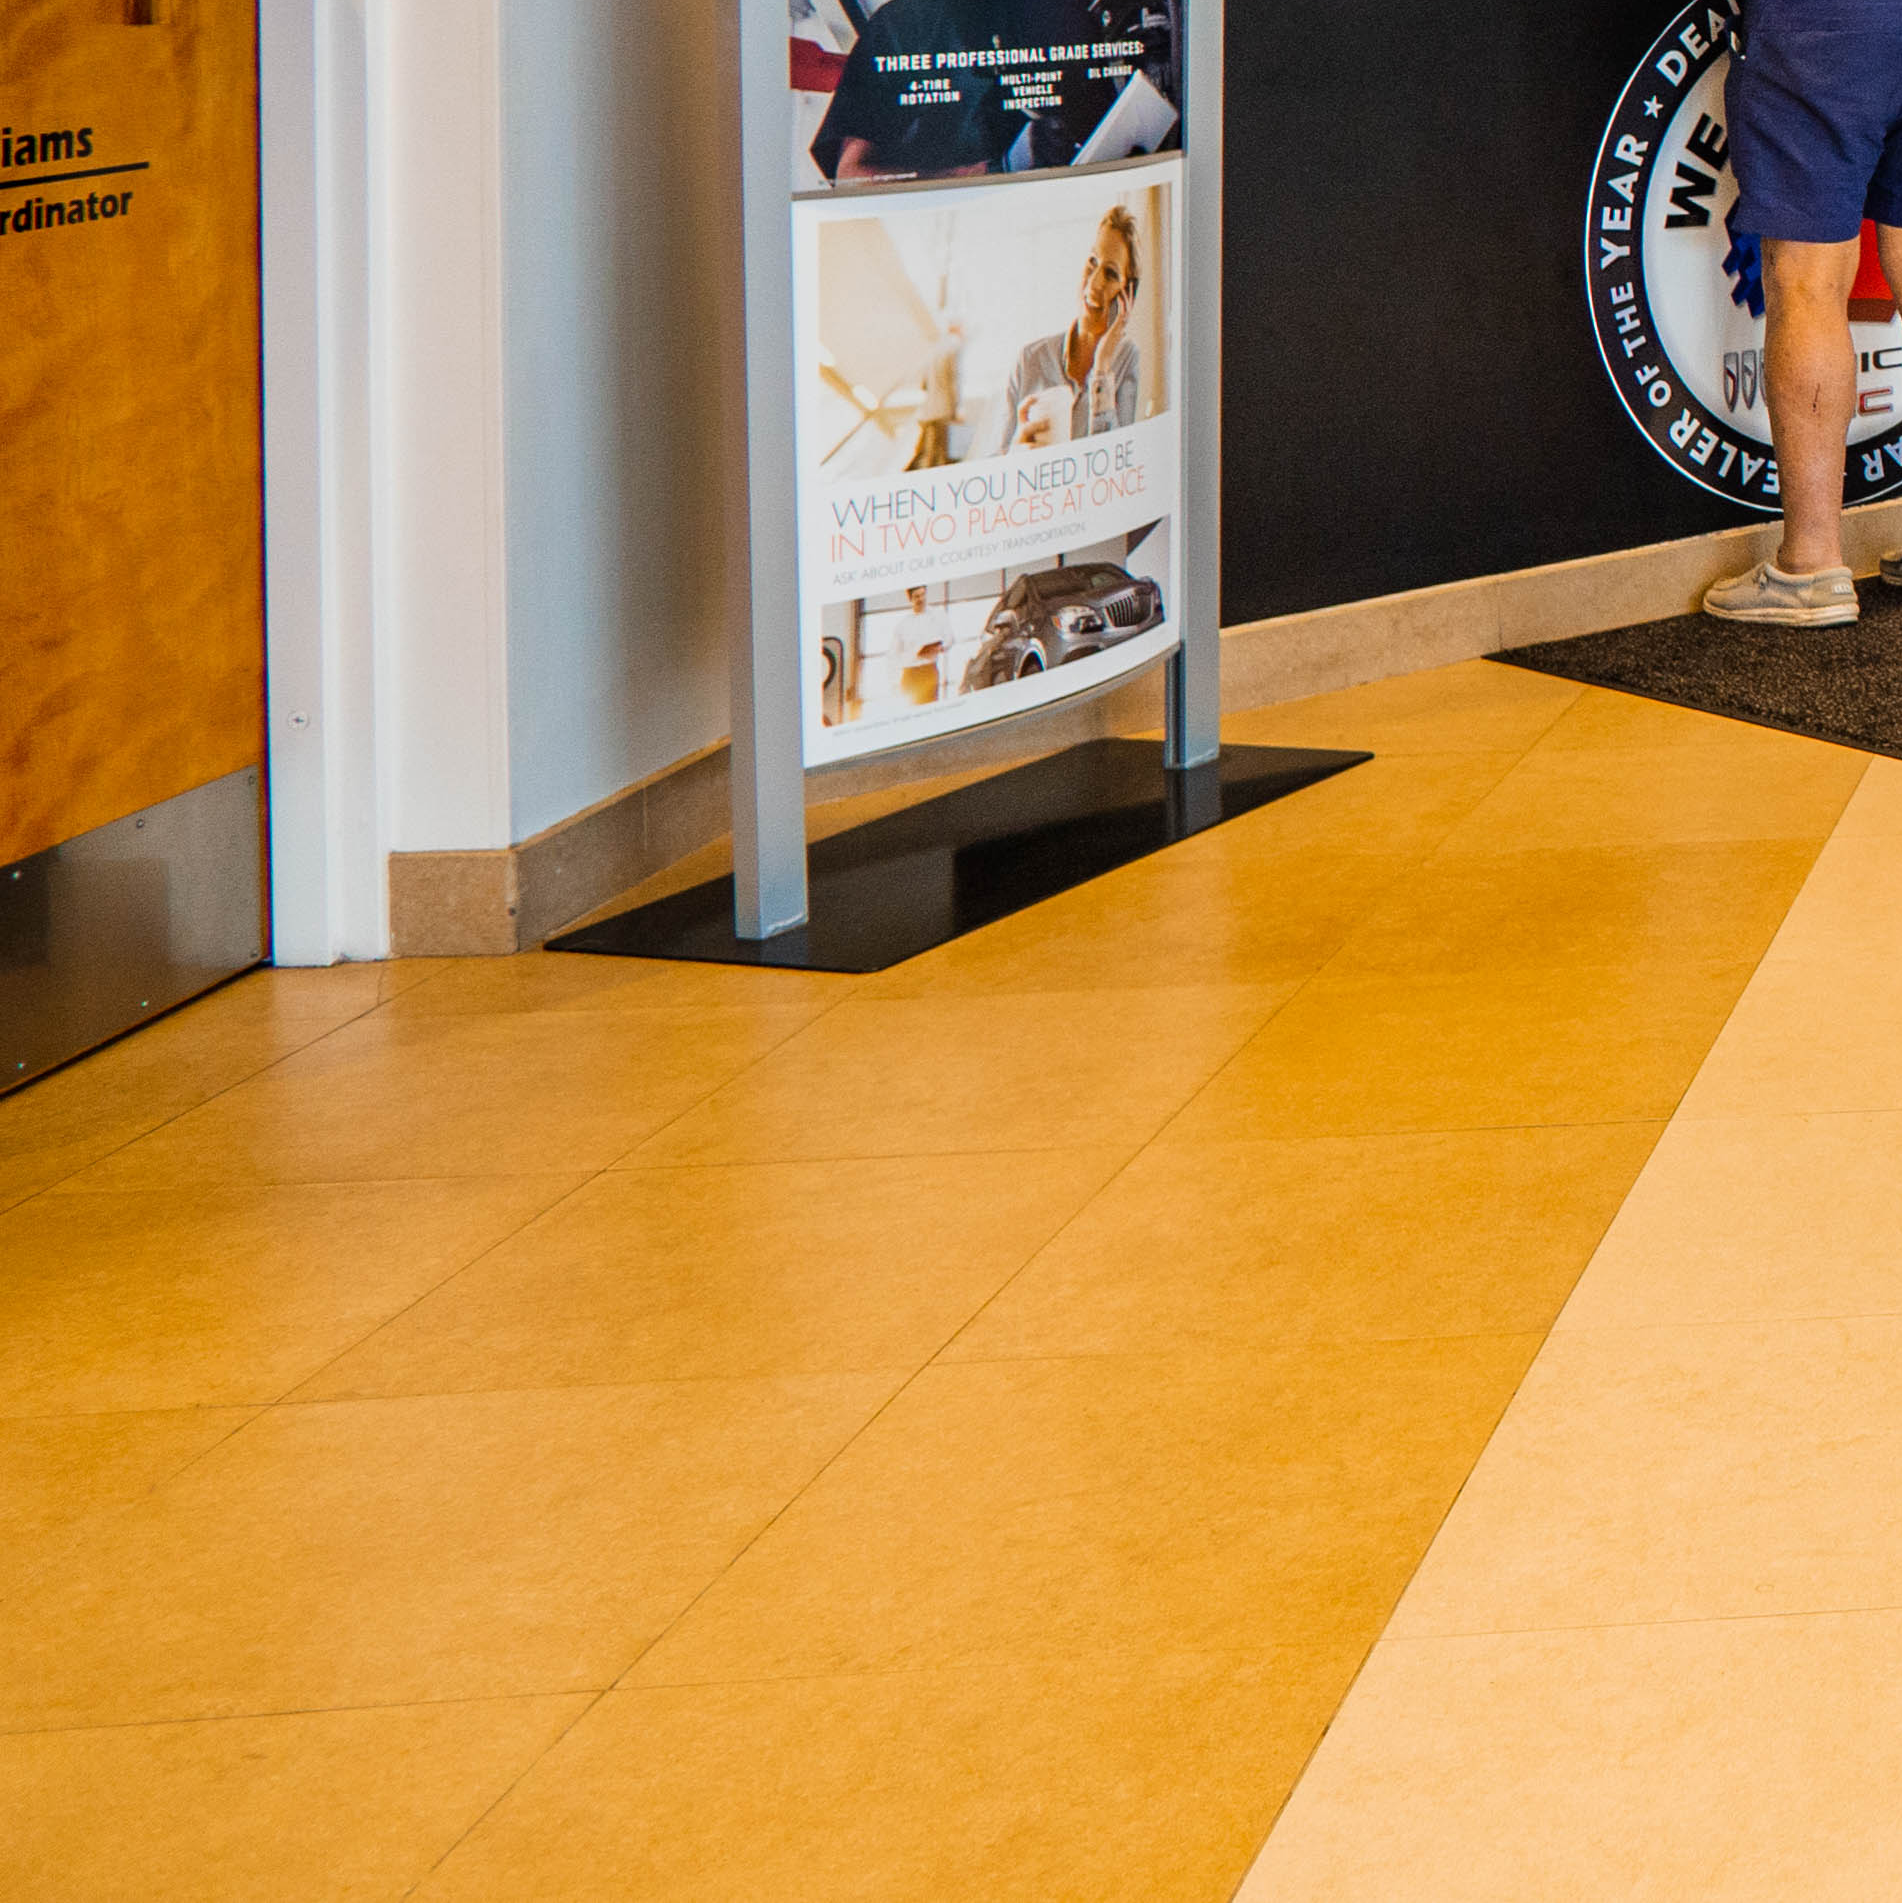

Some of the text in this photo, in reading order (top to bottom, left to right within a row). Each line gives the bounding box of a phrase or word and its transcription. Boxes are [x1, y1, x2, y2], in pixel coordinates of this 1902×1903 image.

[875, 41, 1145, 73] THREE PROFESSIONAL GRADE SERVICES:
[899, 91, 961, 106] ROTATION
[1003, 95, 1062, 111] INSPECTION
[1012, 84, 1054, 97] VEHICLE
[0, 126, 94, 169] iams
[0, 190, 134, 236] rdinator
[1600, 133, 1650, 270] YEAR
[1608, 280, 1652, 359] THE
[1635, 360, 1673, 409] OF
[1667, 407, 1782, 495] EALER
[831, 439, 1134, 530] WHEN YOU NEED TO BE
[830, 466, 1147, 563] IN TWO PLACES AT ONCE
[832, 570, 857, 587] ASK
[860, 560, 906, 581] ABOUT
[908, 554, 937, 574] OUR
[940, 542, 999, 568] COURTESY
